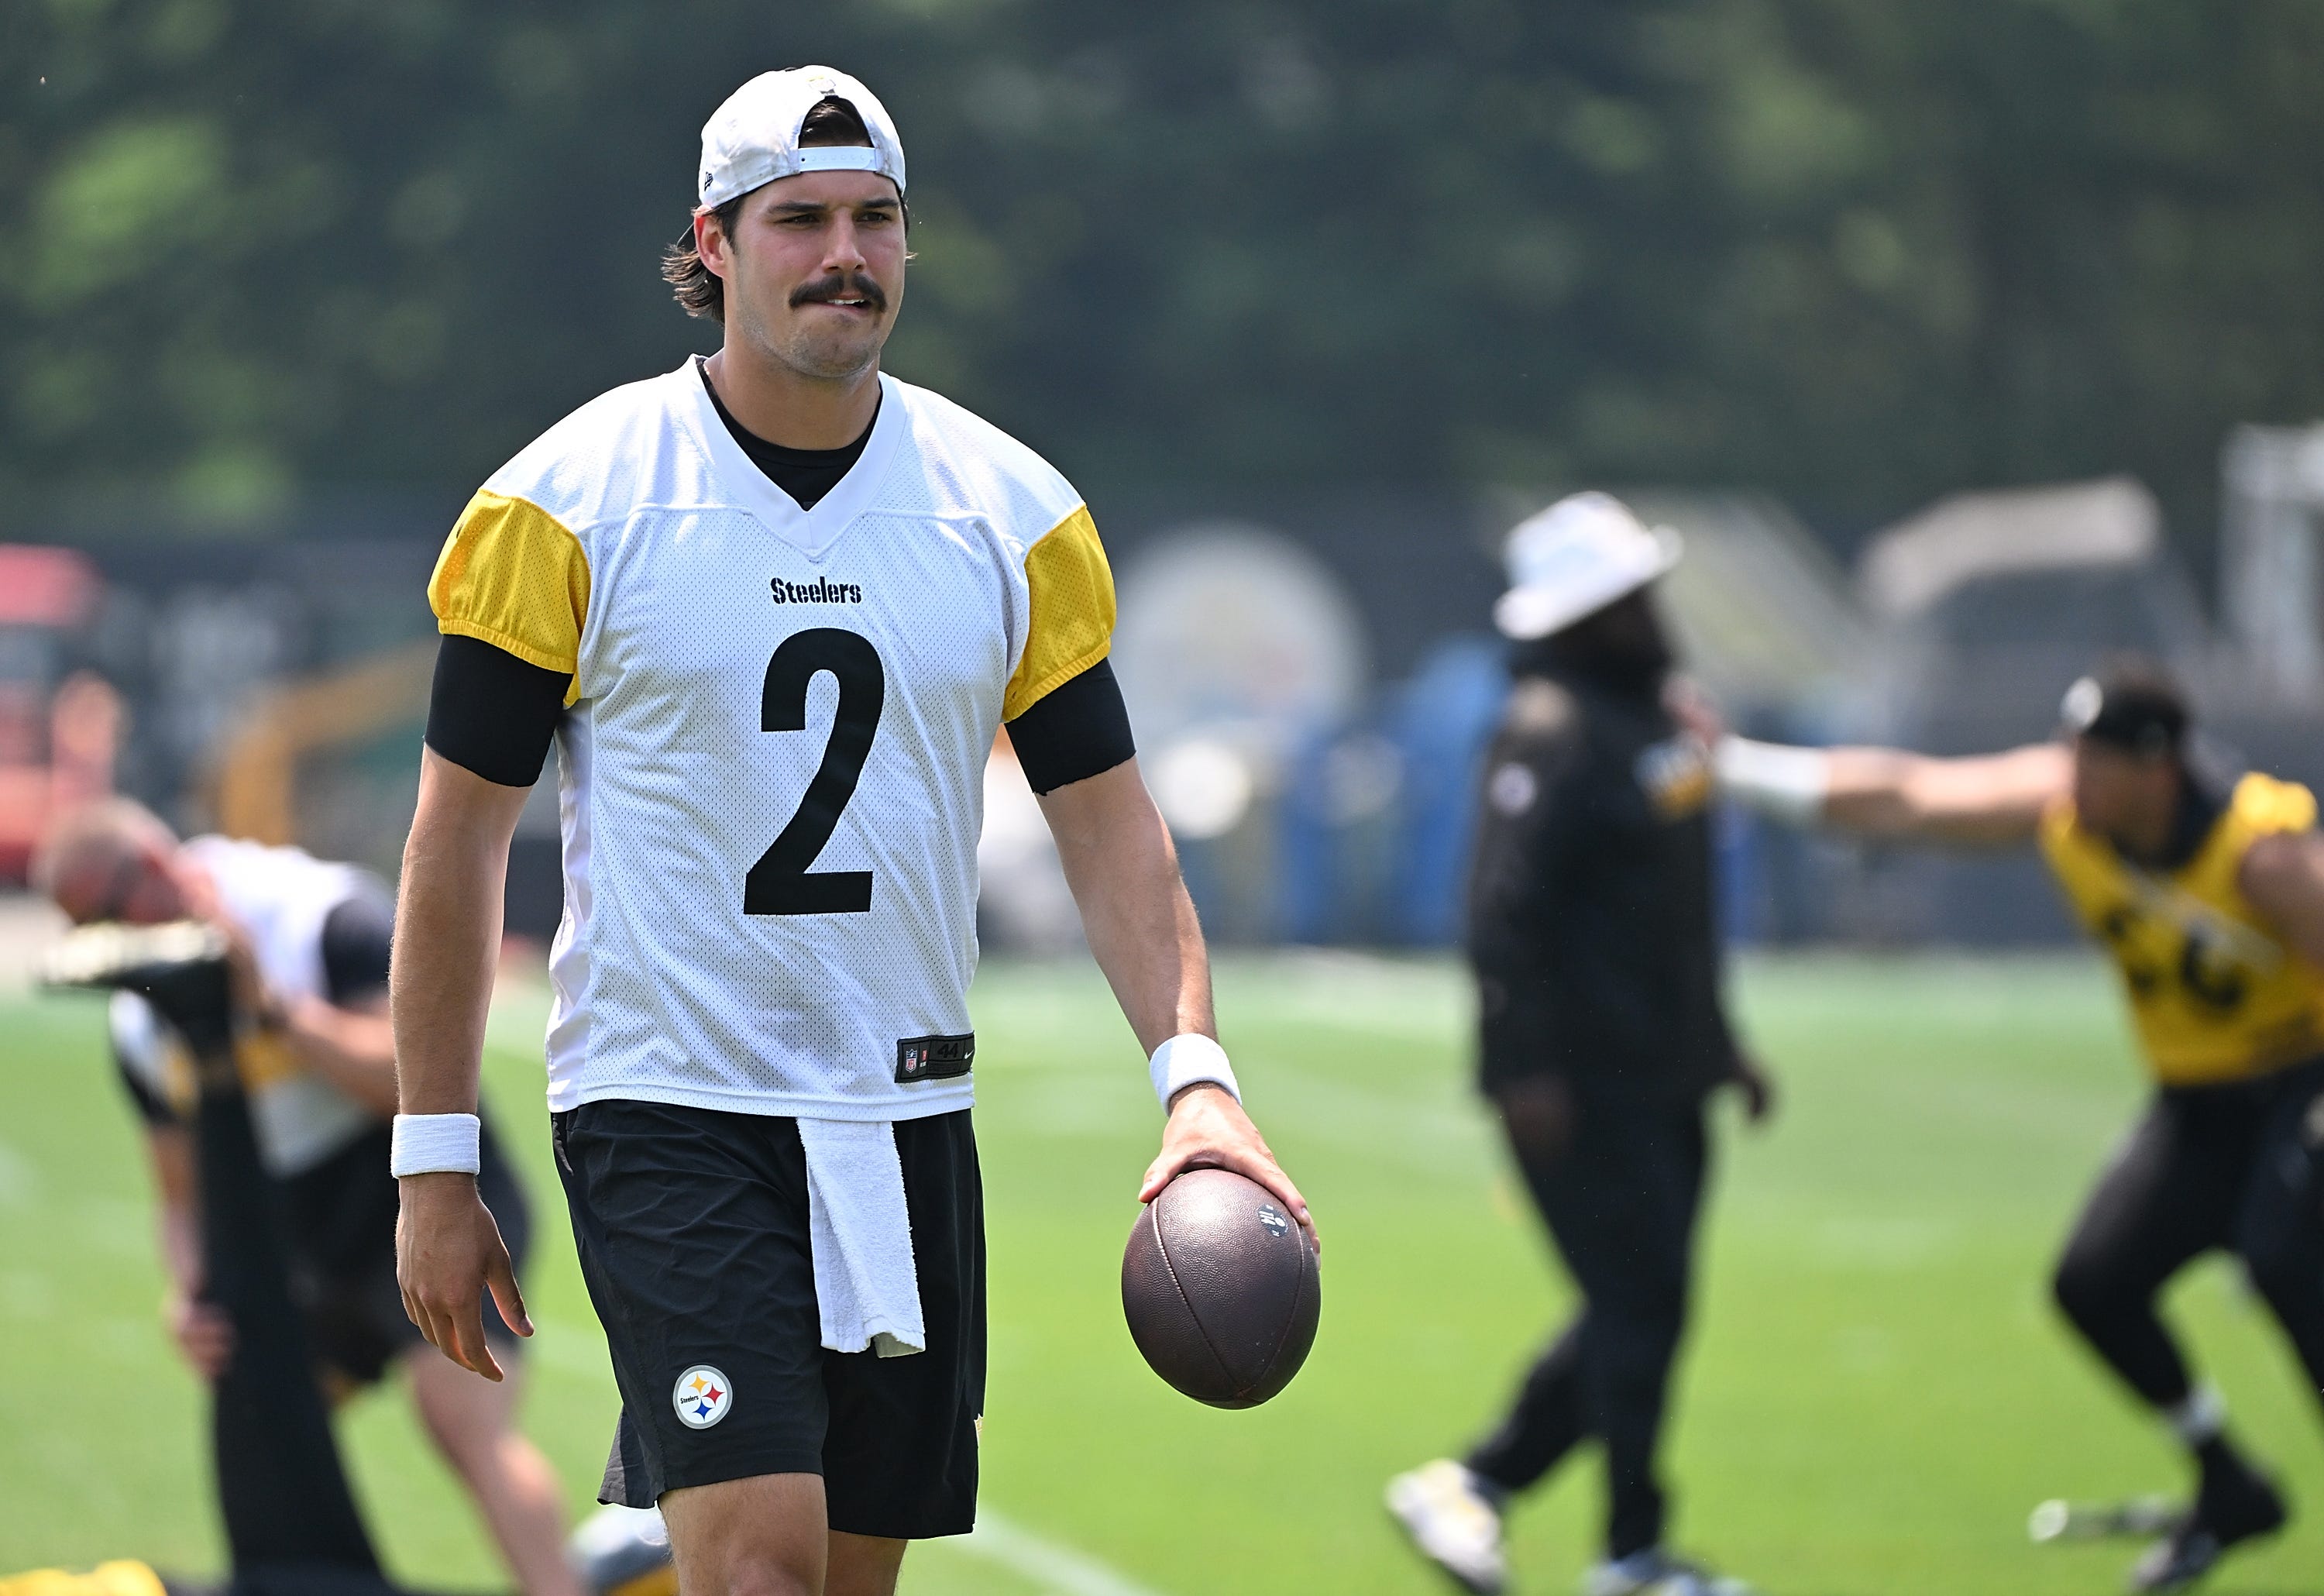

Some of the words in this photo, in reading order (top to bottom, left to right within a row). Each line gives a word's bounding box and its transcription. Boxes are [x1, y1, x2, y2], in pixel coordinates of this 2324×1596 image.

[770, 576, 861, 604] Steelers
[744, 628, 885, 916] 2
[937, 1042, 958, 1058] 44
[680, 1395, 699, 1404] Steelers
